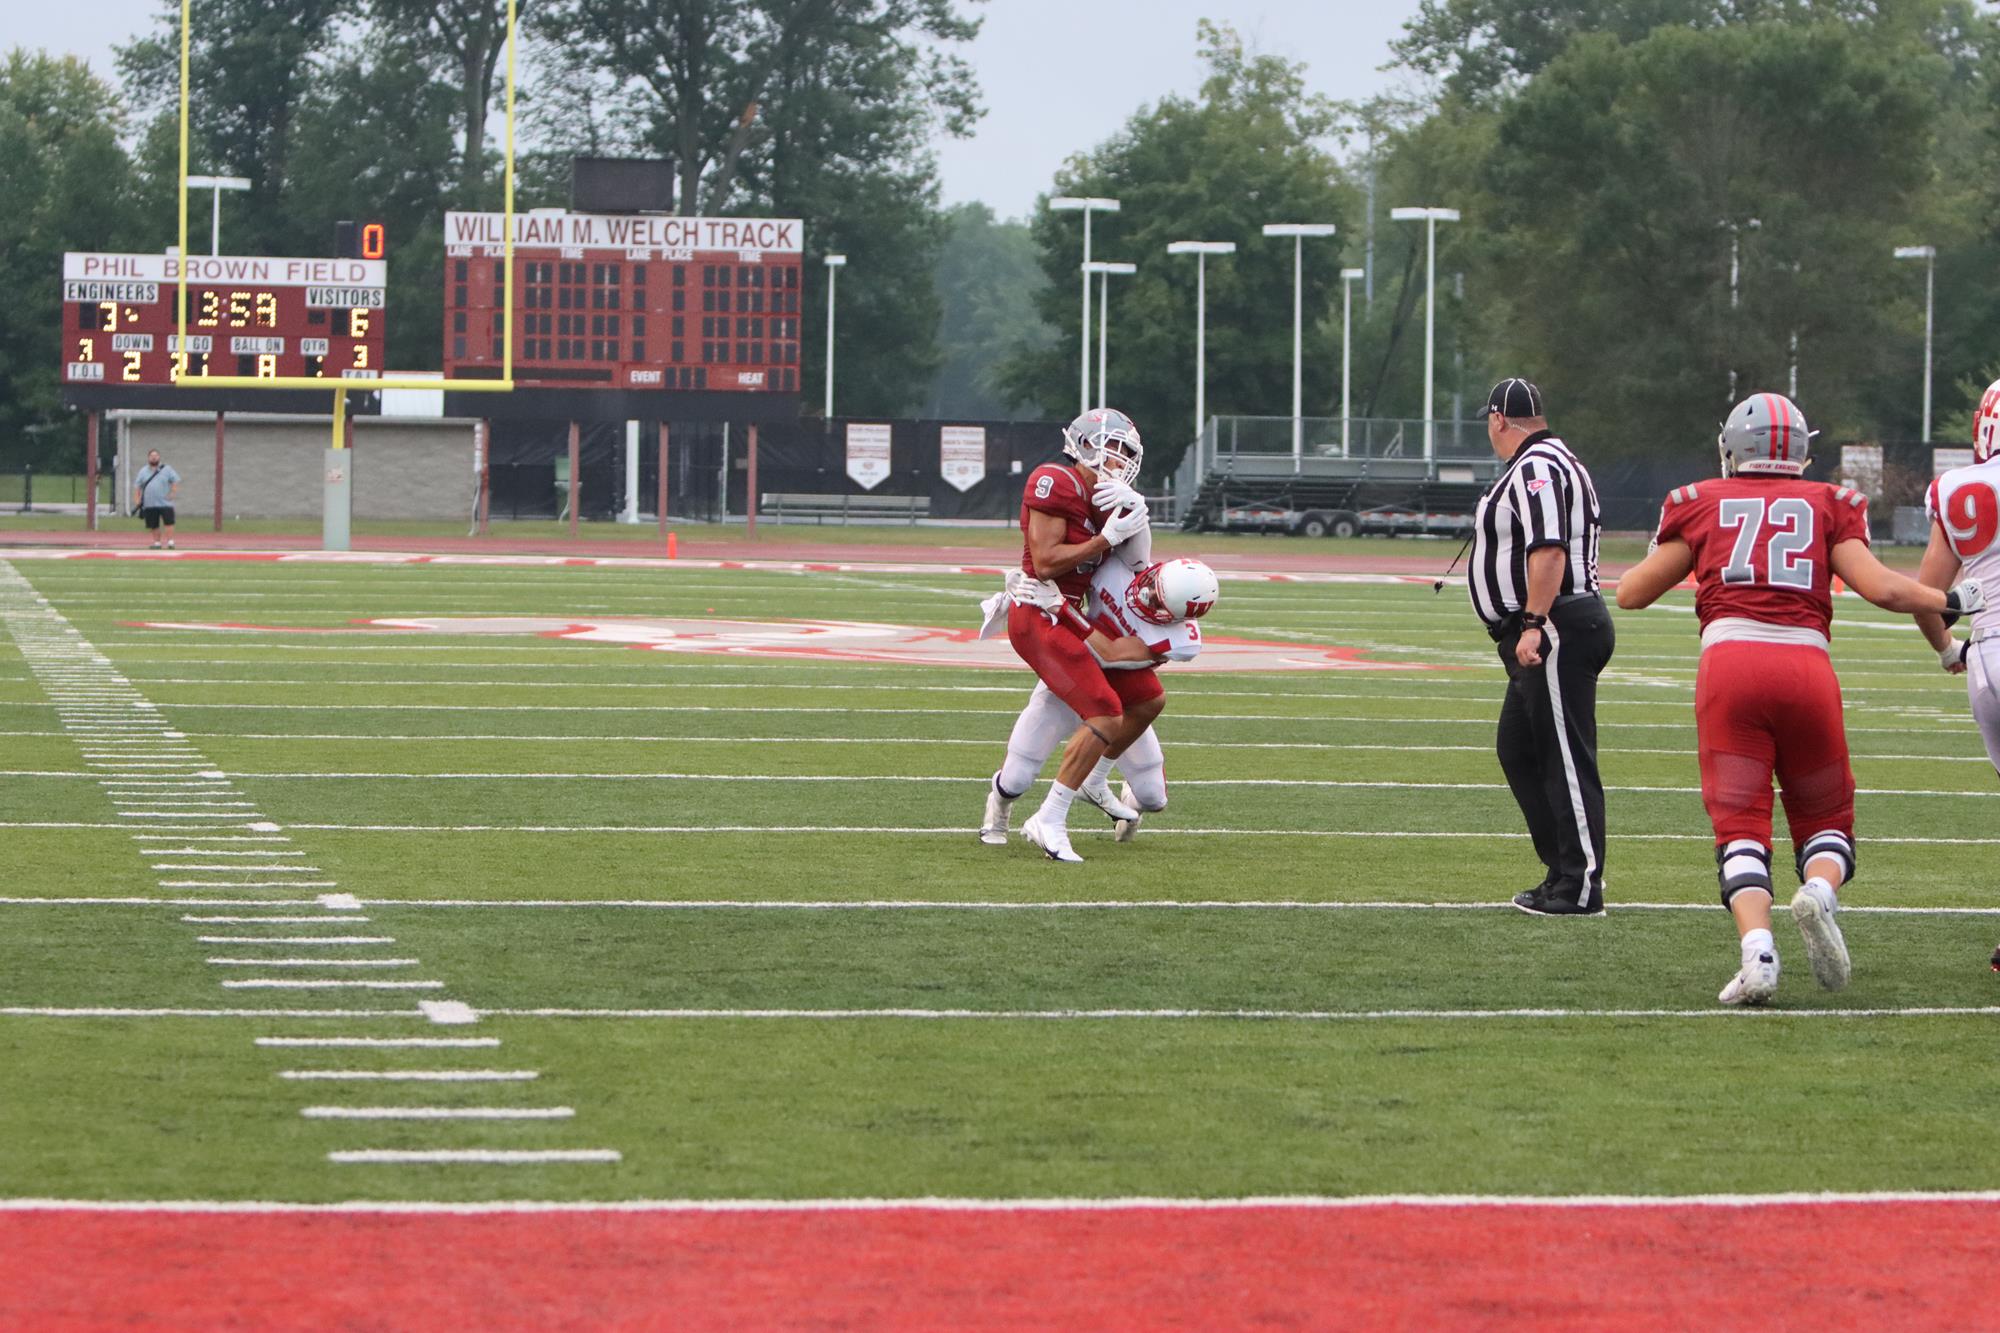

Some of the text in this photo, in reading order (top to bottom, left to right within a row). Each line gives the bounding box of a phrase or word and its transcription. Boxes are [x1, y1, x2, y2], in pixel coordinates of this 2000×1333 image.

[362, 223, 384, 259] 0
[455, 216, 793, 248] WILLIAM M. WELCH TRACK
[484, 246, 515, 257] PLAE
[84, 257, 367, 281] PHIL BROWN FIELD
[68, 283, 156, 301] ENGINEERS
[309, 288, 381, 306] VISITORS
[351, 308, 369, 337] 6
[115, 335, 150, 348] DOWN
[193, 337, 209, 350] GO
[234, 339, 281, 351] BALL ON
[303, 340, 326, 352] QTR
[353, 345, 368, 368] 3
[123, 351, 141, 381] 2
[630, 370, 662, 384] EVENT
[738, 372, 764, 385] HEAT
[1035, 475, 1054, 499] 9
[1719, 497, 1814, 590] 72
[1185, 623, 1199, 640] 3
